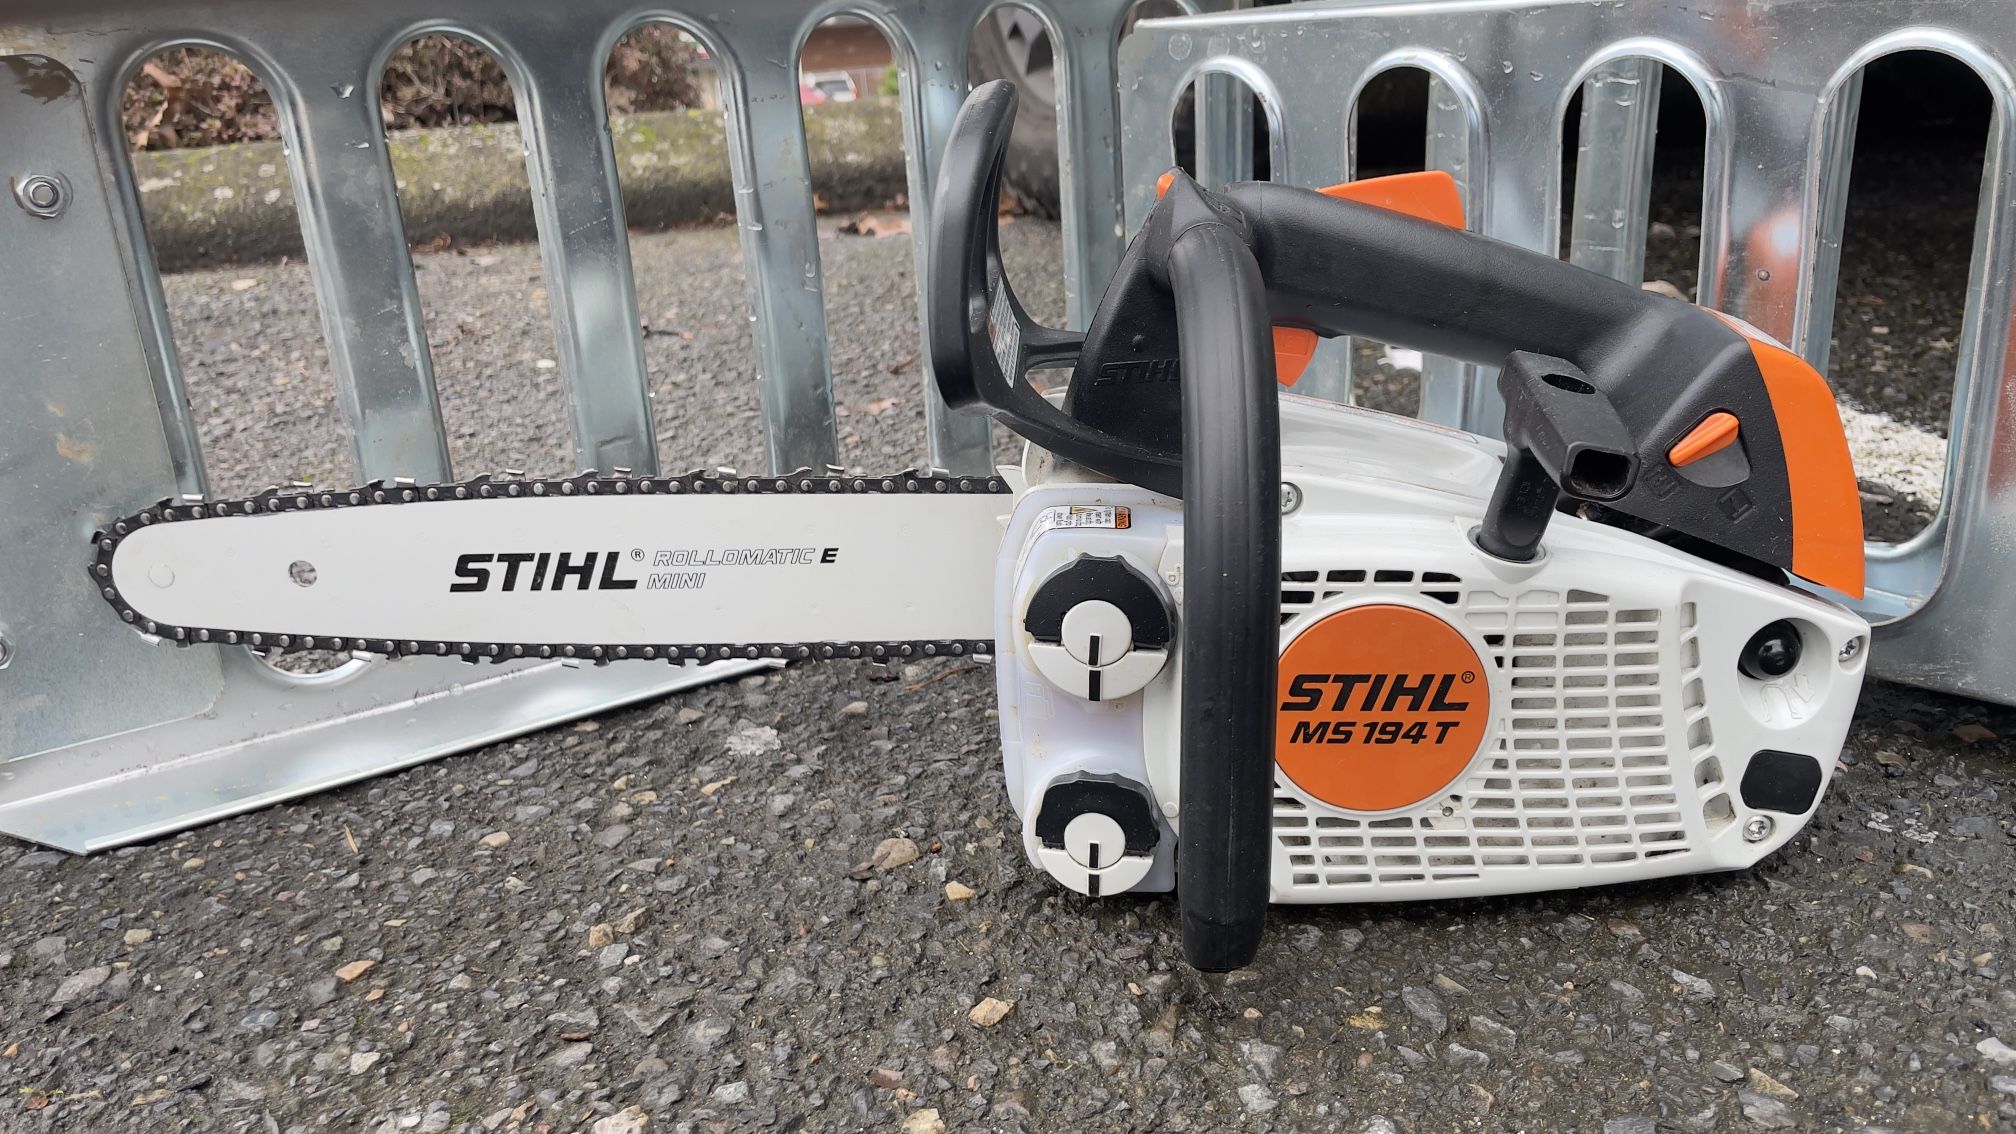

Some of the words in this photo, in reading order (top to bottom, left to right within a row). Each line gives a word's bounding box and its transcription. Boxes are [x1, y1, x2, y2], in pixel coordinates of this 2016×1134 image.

[653, 547, 815, 567] ROLLOMATIC
[820, 547, 839, 564] E
[647, 572, 707, 590] MINI
[1289, 721, 1357, 744] MS
[1363, 721, 1429, 744] 194
[1435, 721, 1460, 744] T
